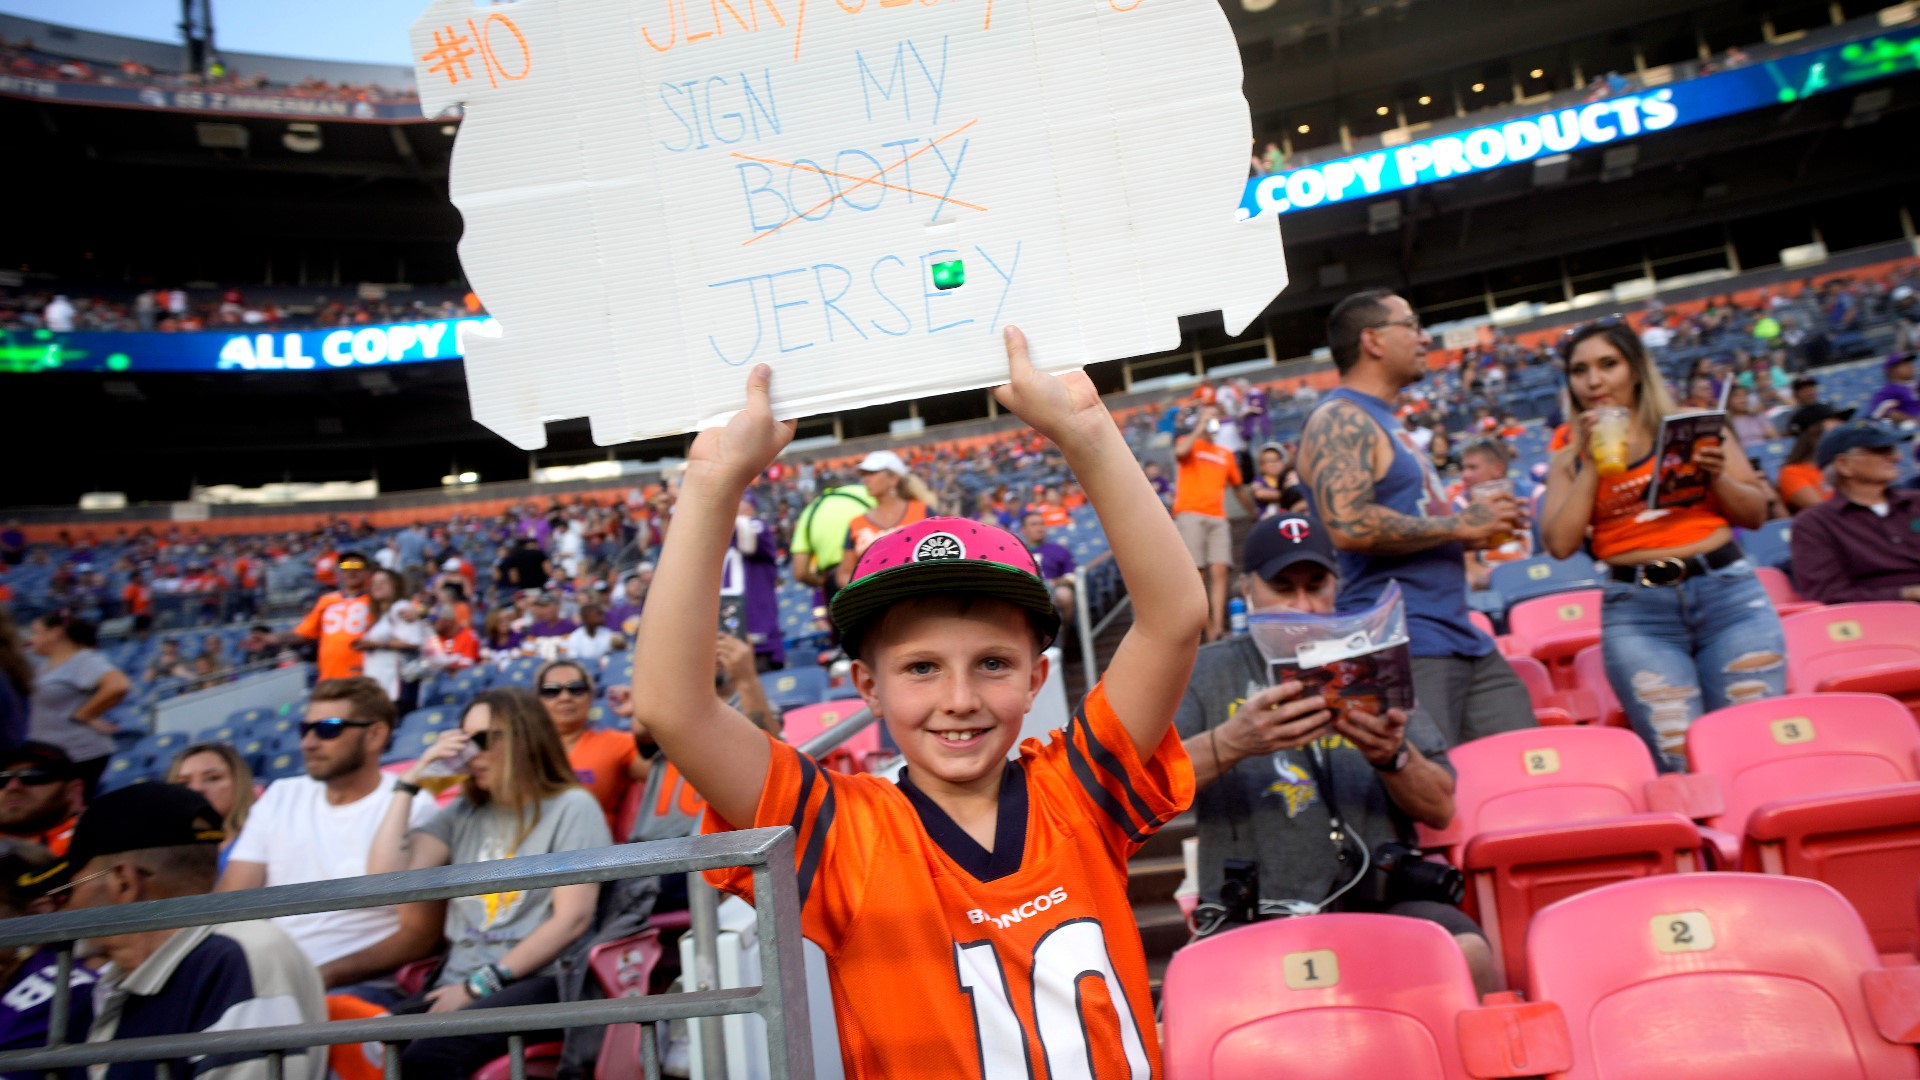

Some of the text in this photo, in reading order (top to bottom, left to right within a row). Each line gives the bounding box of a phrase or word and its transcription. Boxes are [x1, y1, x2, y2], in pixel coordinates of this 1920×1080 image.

[422, 12, 531, 88] #10
[659, 35, 948, 151] SIGN MY
[1256, 88, 1678, 213] COPY PRODUCTS
[735, 137, 969, 232] BOOTY
[708, 241, 1021, 366] JERSEY
[217, 333, 315, 370] ALL
[322, 322, 448, 367] COPY
[322, 601, 369, 635] 58
[1782, 722, 1801, 739] 3
[1530, 754, 1546, 770] 2
[1669, 920, 1694, 944] 2
[952, 916, 1152, 1080] 10
[1302, 958, 1319, 981] 1
